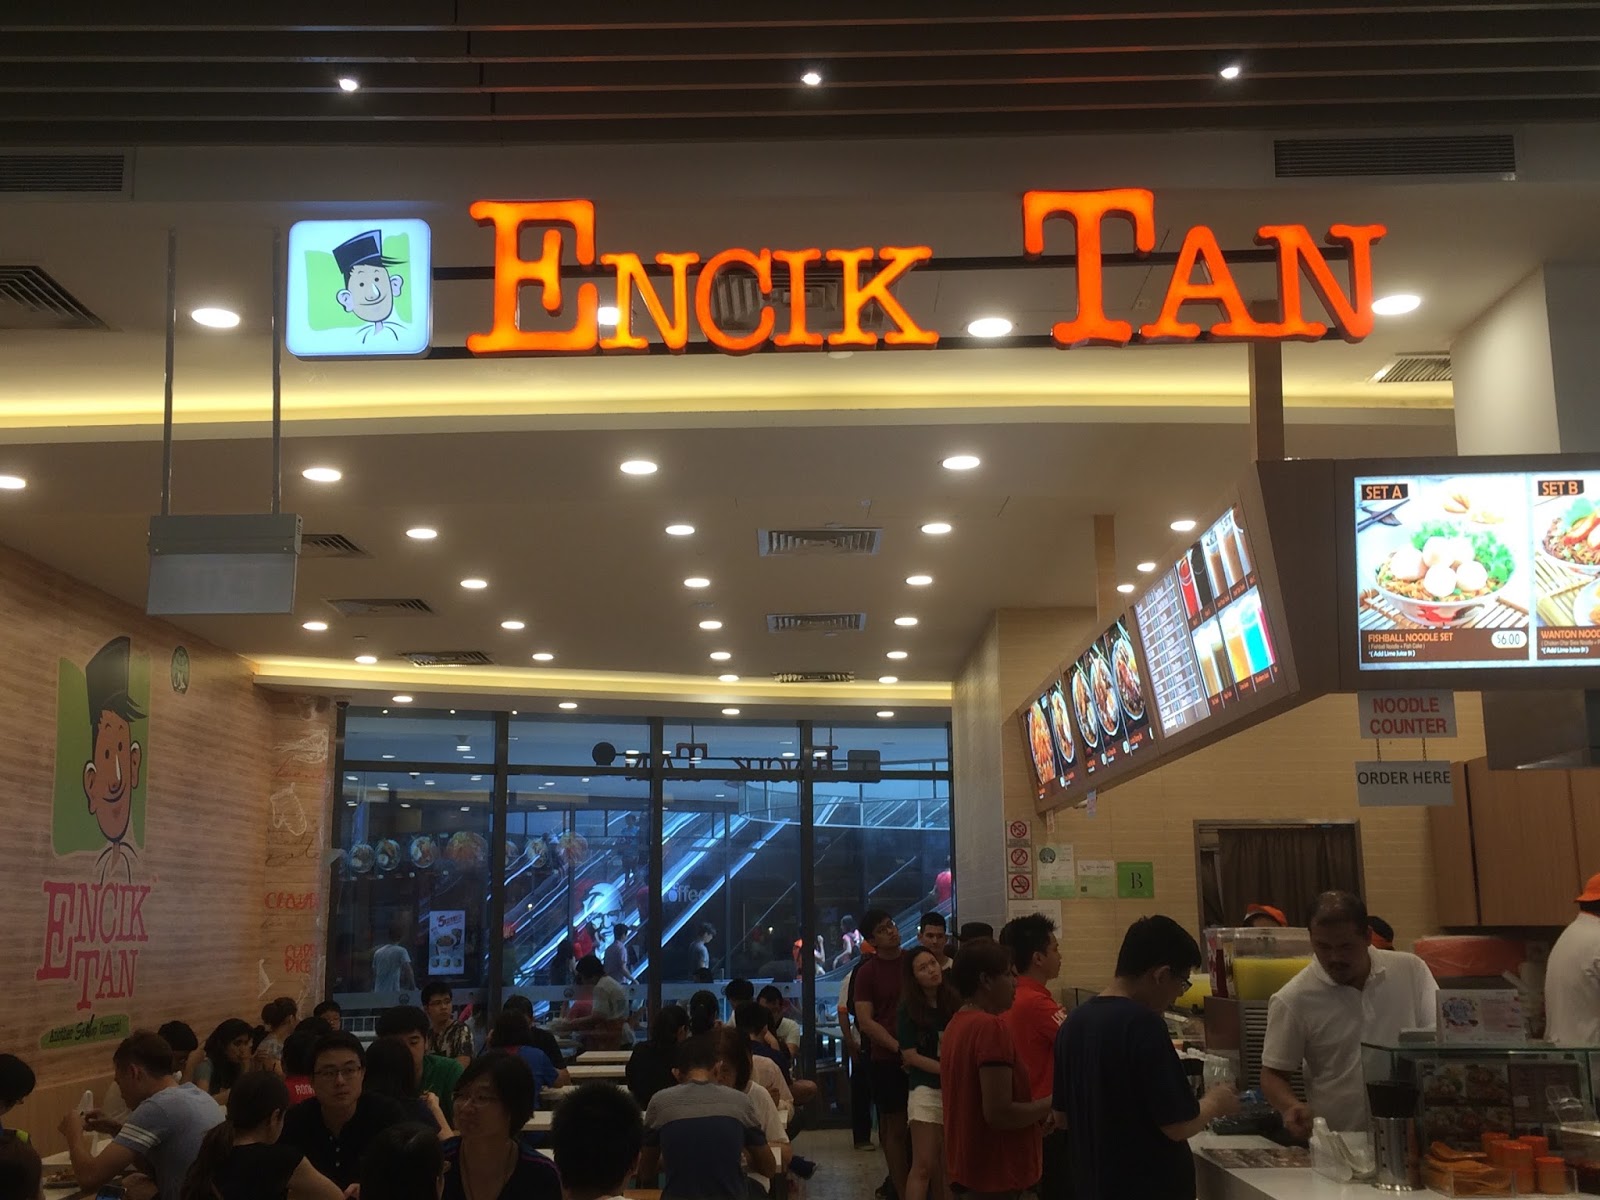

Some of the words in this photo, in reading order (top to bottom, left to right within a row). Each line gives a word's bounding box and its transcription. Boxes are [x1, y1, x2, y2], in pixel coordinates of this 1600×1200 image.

[467, 199, 939, 356] ENCIK
[1022, 188, 1387, 350] TAN
[1366, 485, 1389, 500] SET
[1392, 484, 1403, 499] A
[1542, 481, 1565, 496] SET
[1568, 481, 1579, 495] B
[1368, 633, 1404, 643] FISHBALL
[1405, 632, 1439, 642] NOODLE
[1440, 632, 1454, 641] SET
[1497, 633, 1520, 645] $6.00
[1541, 630, 1578, 639] WANTON
[1373, 697, 1440, 713] NOODLE
[1370, 718, 1447, 735] COUNTER
[1357, 771, 1409, 785] ORDER
[1413, 771, 1451, 785] HERE
[1130, 872, 1144, 890] B
[36, 880, 151, 981] ENCIK
[74, 949, 139, 1011] TAN
